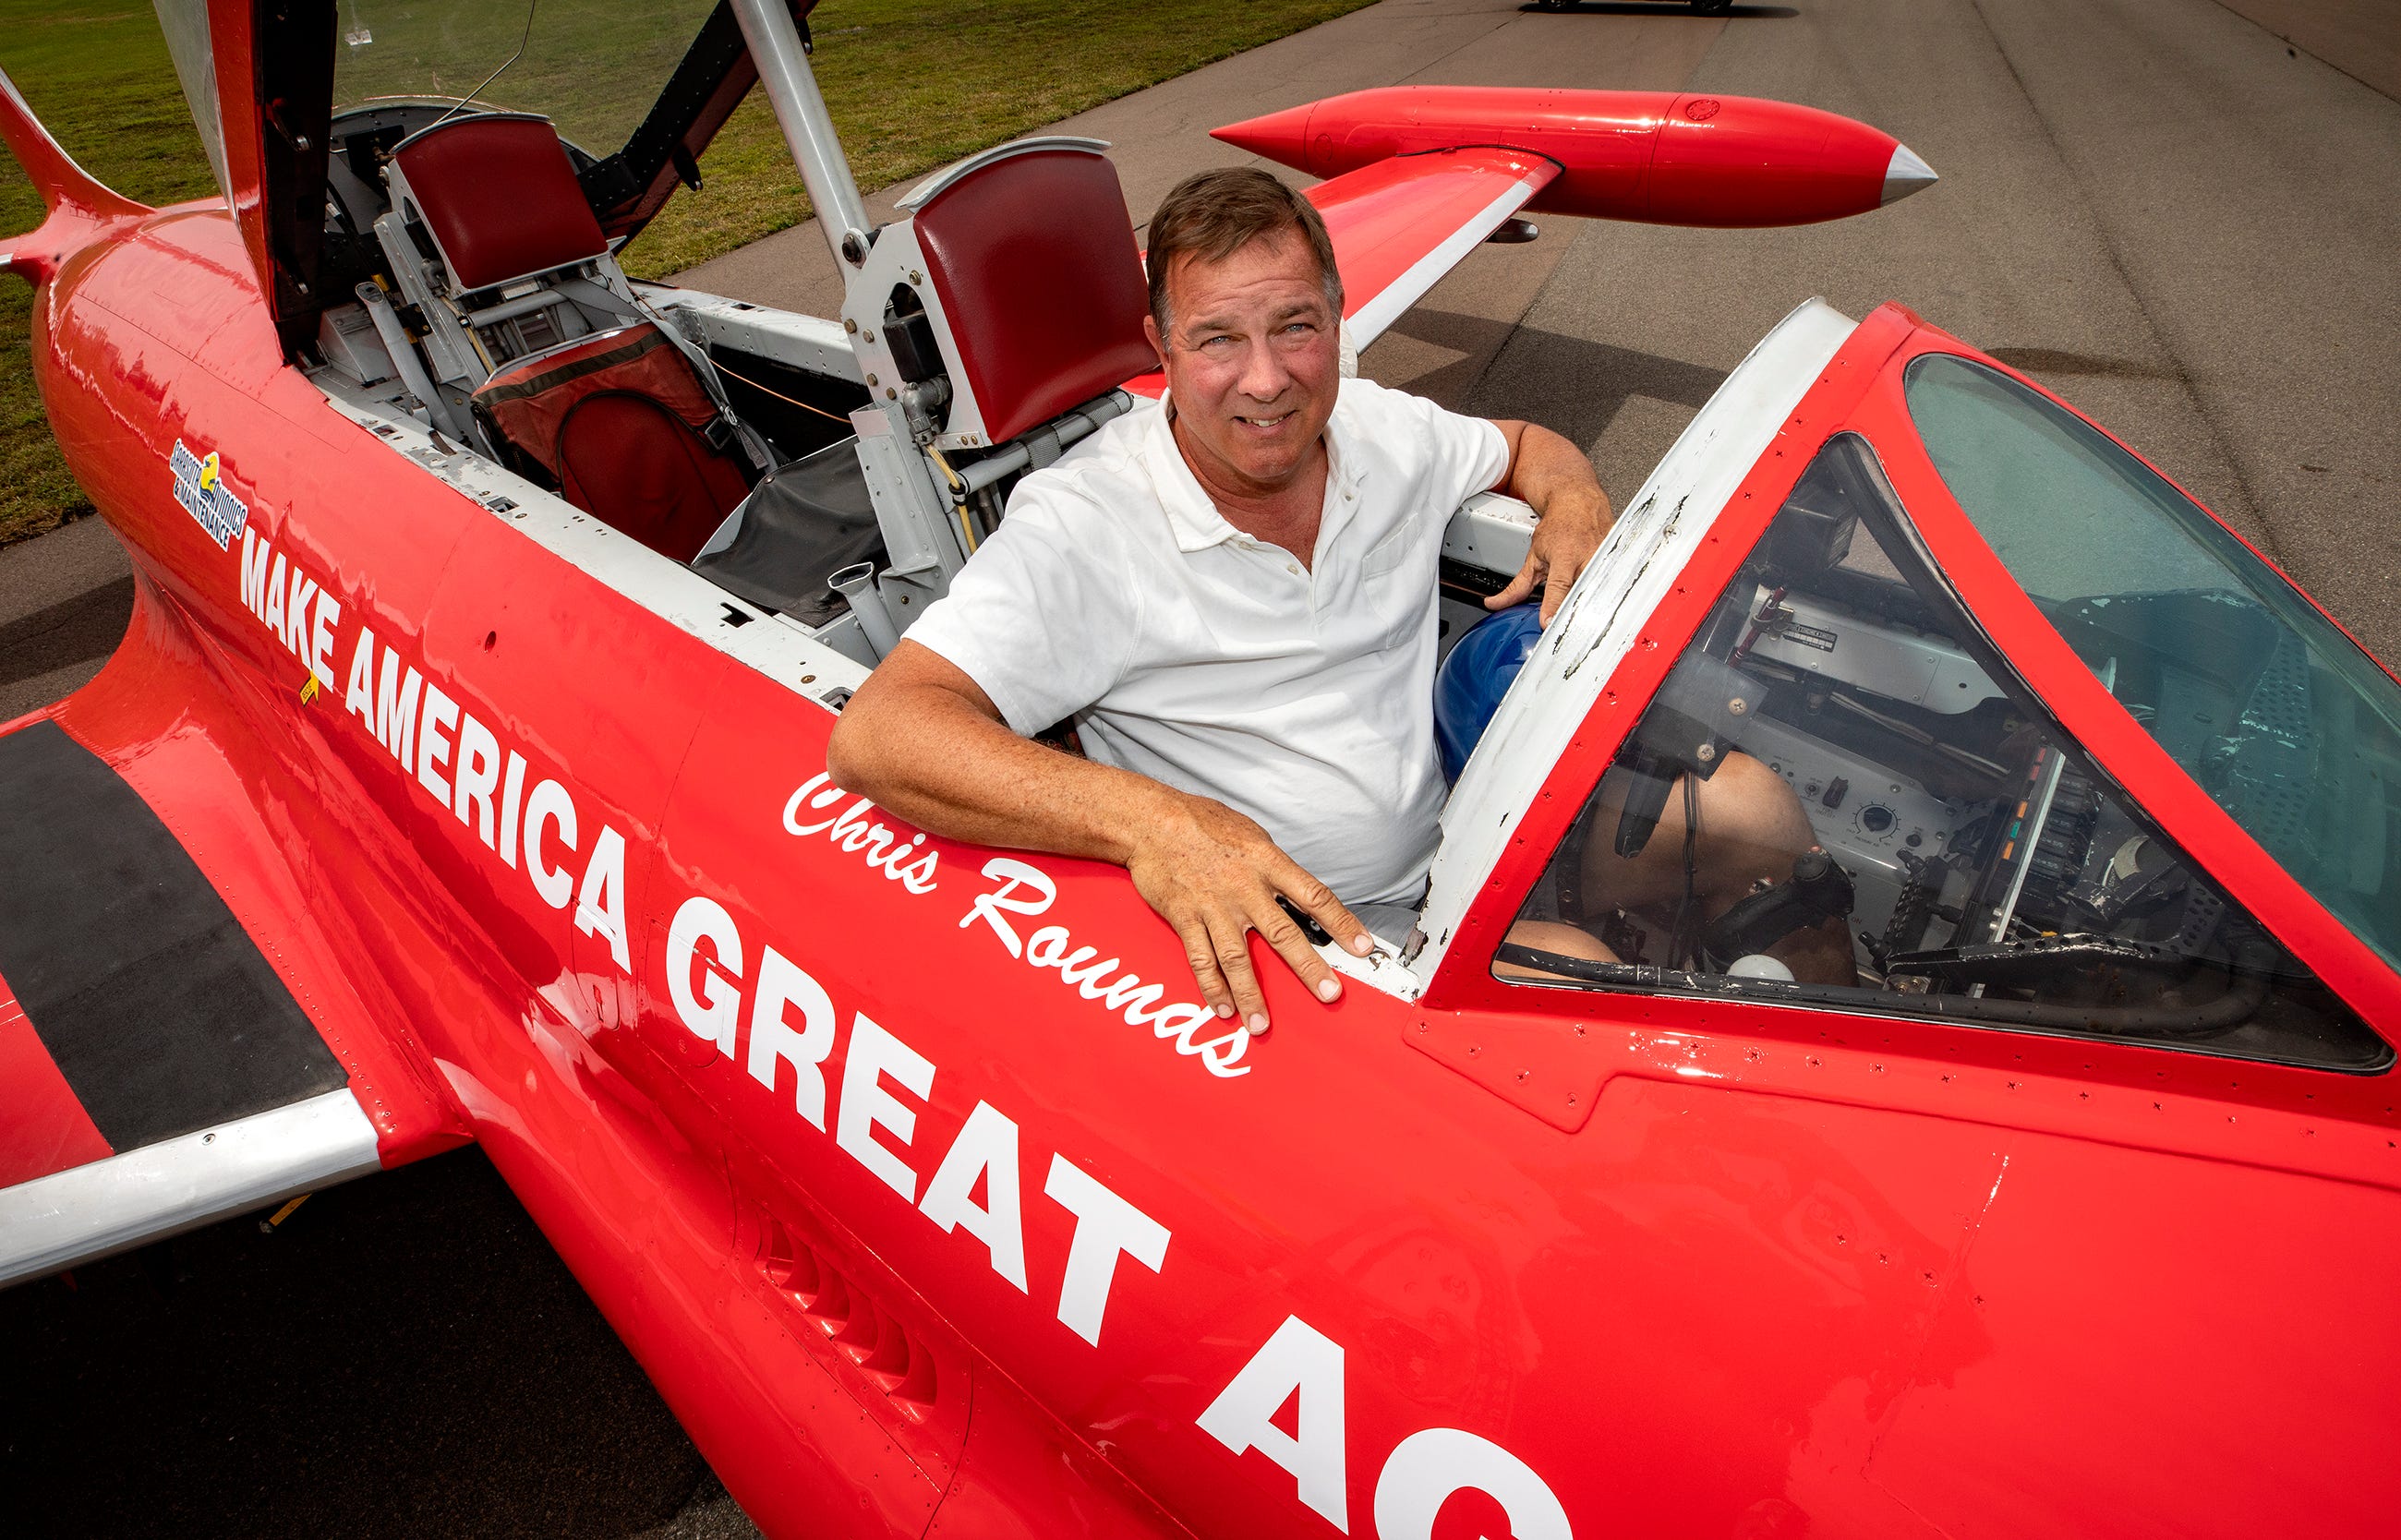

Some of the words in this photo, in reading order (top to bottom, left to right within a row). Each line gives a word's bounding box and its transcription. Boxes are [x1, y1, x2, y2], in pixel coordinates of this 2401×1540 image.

[179, 479, 230, 549] MAINTENANCE
[240, 524, 342, 693] MAKE
[345, 626, 632, 976] AMERICA
[666, 896, 1172, 1349] GREAT
[782, 770, 938, 895] Chris
[959, 857, 1251, 1078] Rounds
